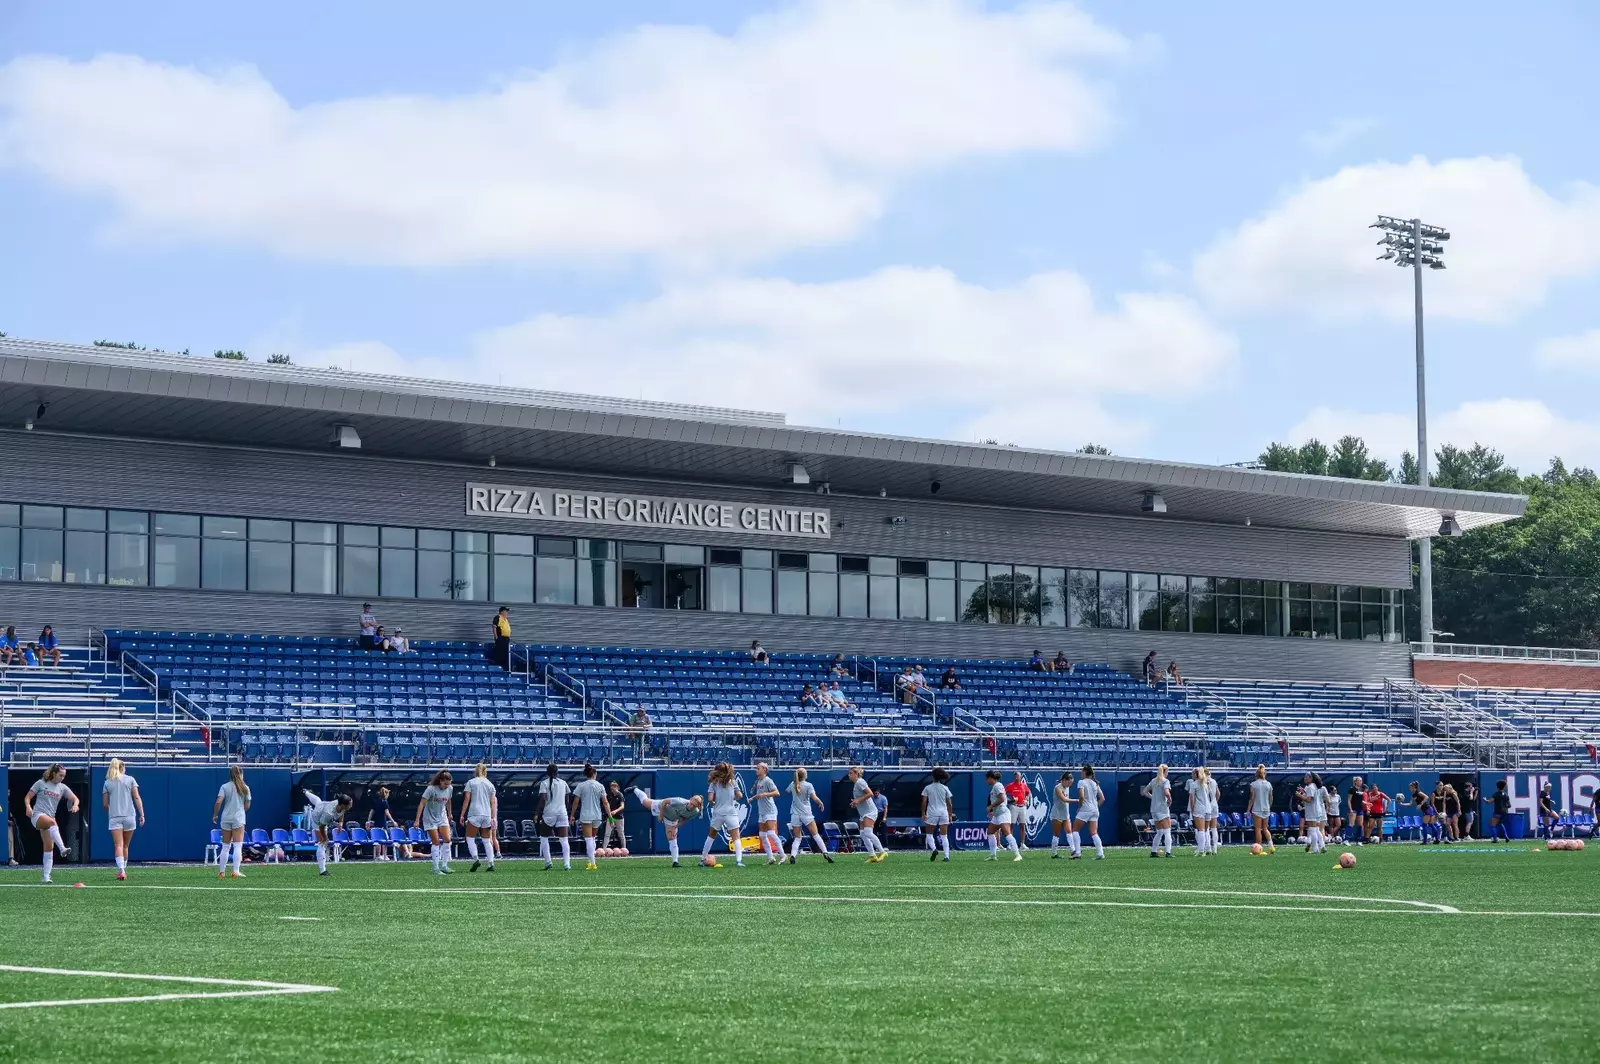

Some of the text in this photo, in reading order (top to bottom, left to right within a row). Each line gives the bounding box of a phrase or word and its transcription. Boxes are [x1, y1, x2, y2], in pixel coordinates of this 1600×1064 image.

[471, 487, 828, 534] RIZZA PERFORMANCE CENTER
[955, 828, 988, 840] UCON
